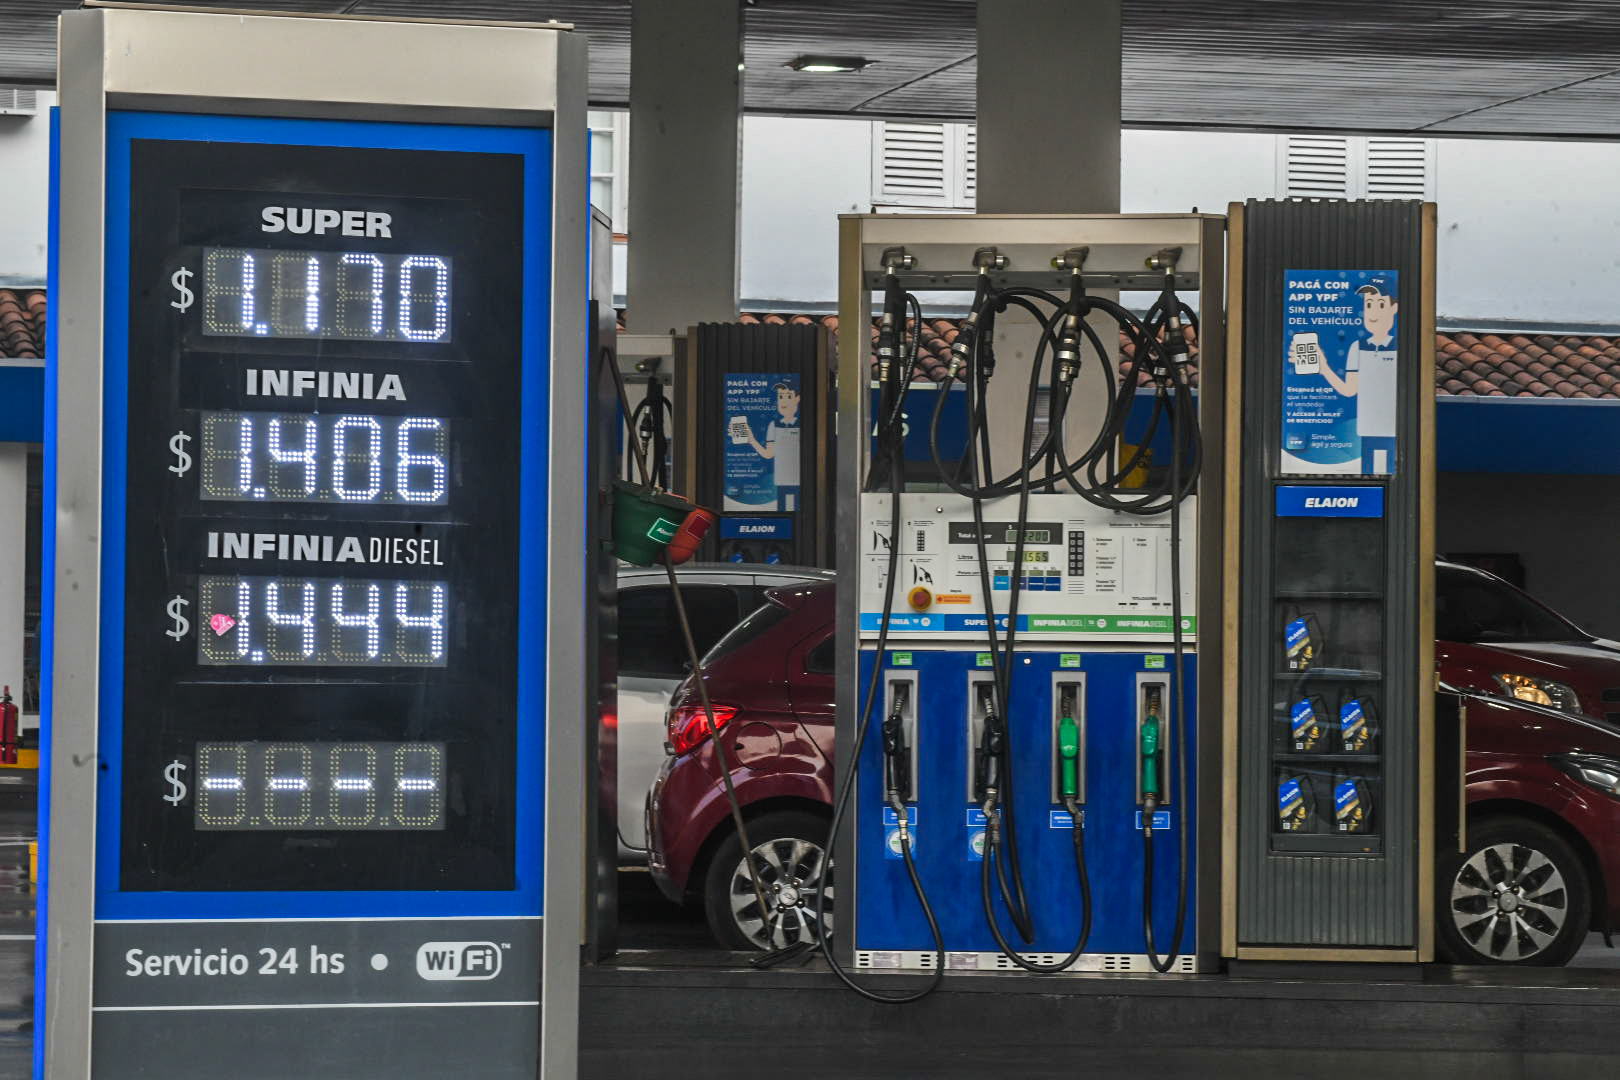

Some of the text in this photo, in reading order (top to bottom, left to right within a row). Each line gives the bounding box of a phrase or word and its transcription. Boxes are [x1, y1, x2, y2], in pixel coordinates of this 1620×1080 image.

[261, 207, 392, 239] SUPER
[170, 253, 448, 341] $ 1.170
[1289, 279, 1349, 289] PAGÁ CON
[1289, 293, 1338, 301] APP YPF
[1288, 306, 1353, 314] SIN BAJARTE
[1289, 316, 1362, 325] DEL VEHÍCULO
[246, 369, 407, 401] INFINIA
[168, 416, 445, 502] $ 1.406
[1304, 497, 1359, 508] ELAION
[739, 525, 776, 533] ELAION
[207, 531, 444, 566] INFINIA DIESEL
[165, 581, 444, 662] $ 1.444
[964, 618, 988, 626] SUPE
[162, 759, 187, 806] $
[125, 944, 345, 977] Servicio 24 hs
